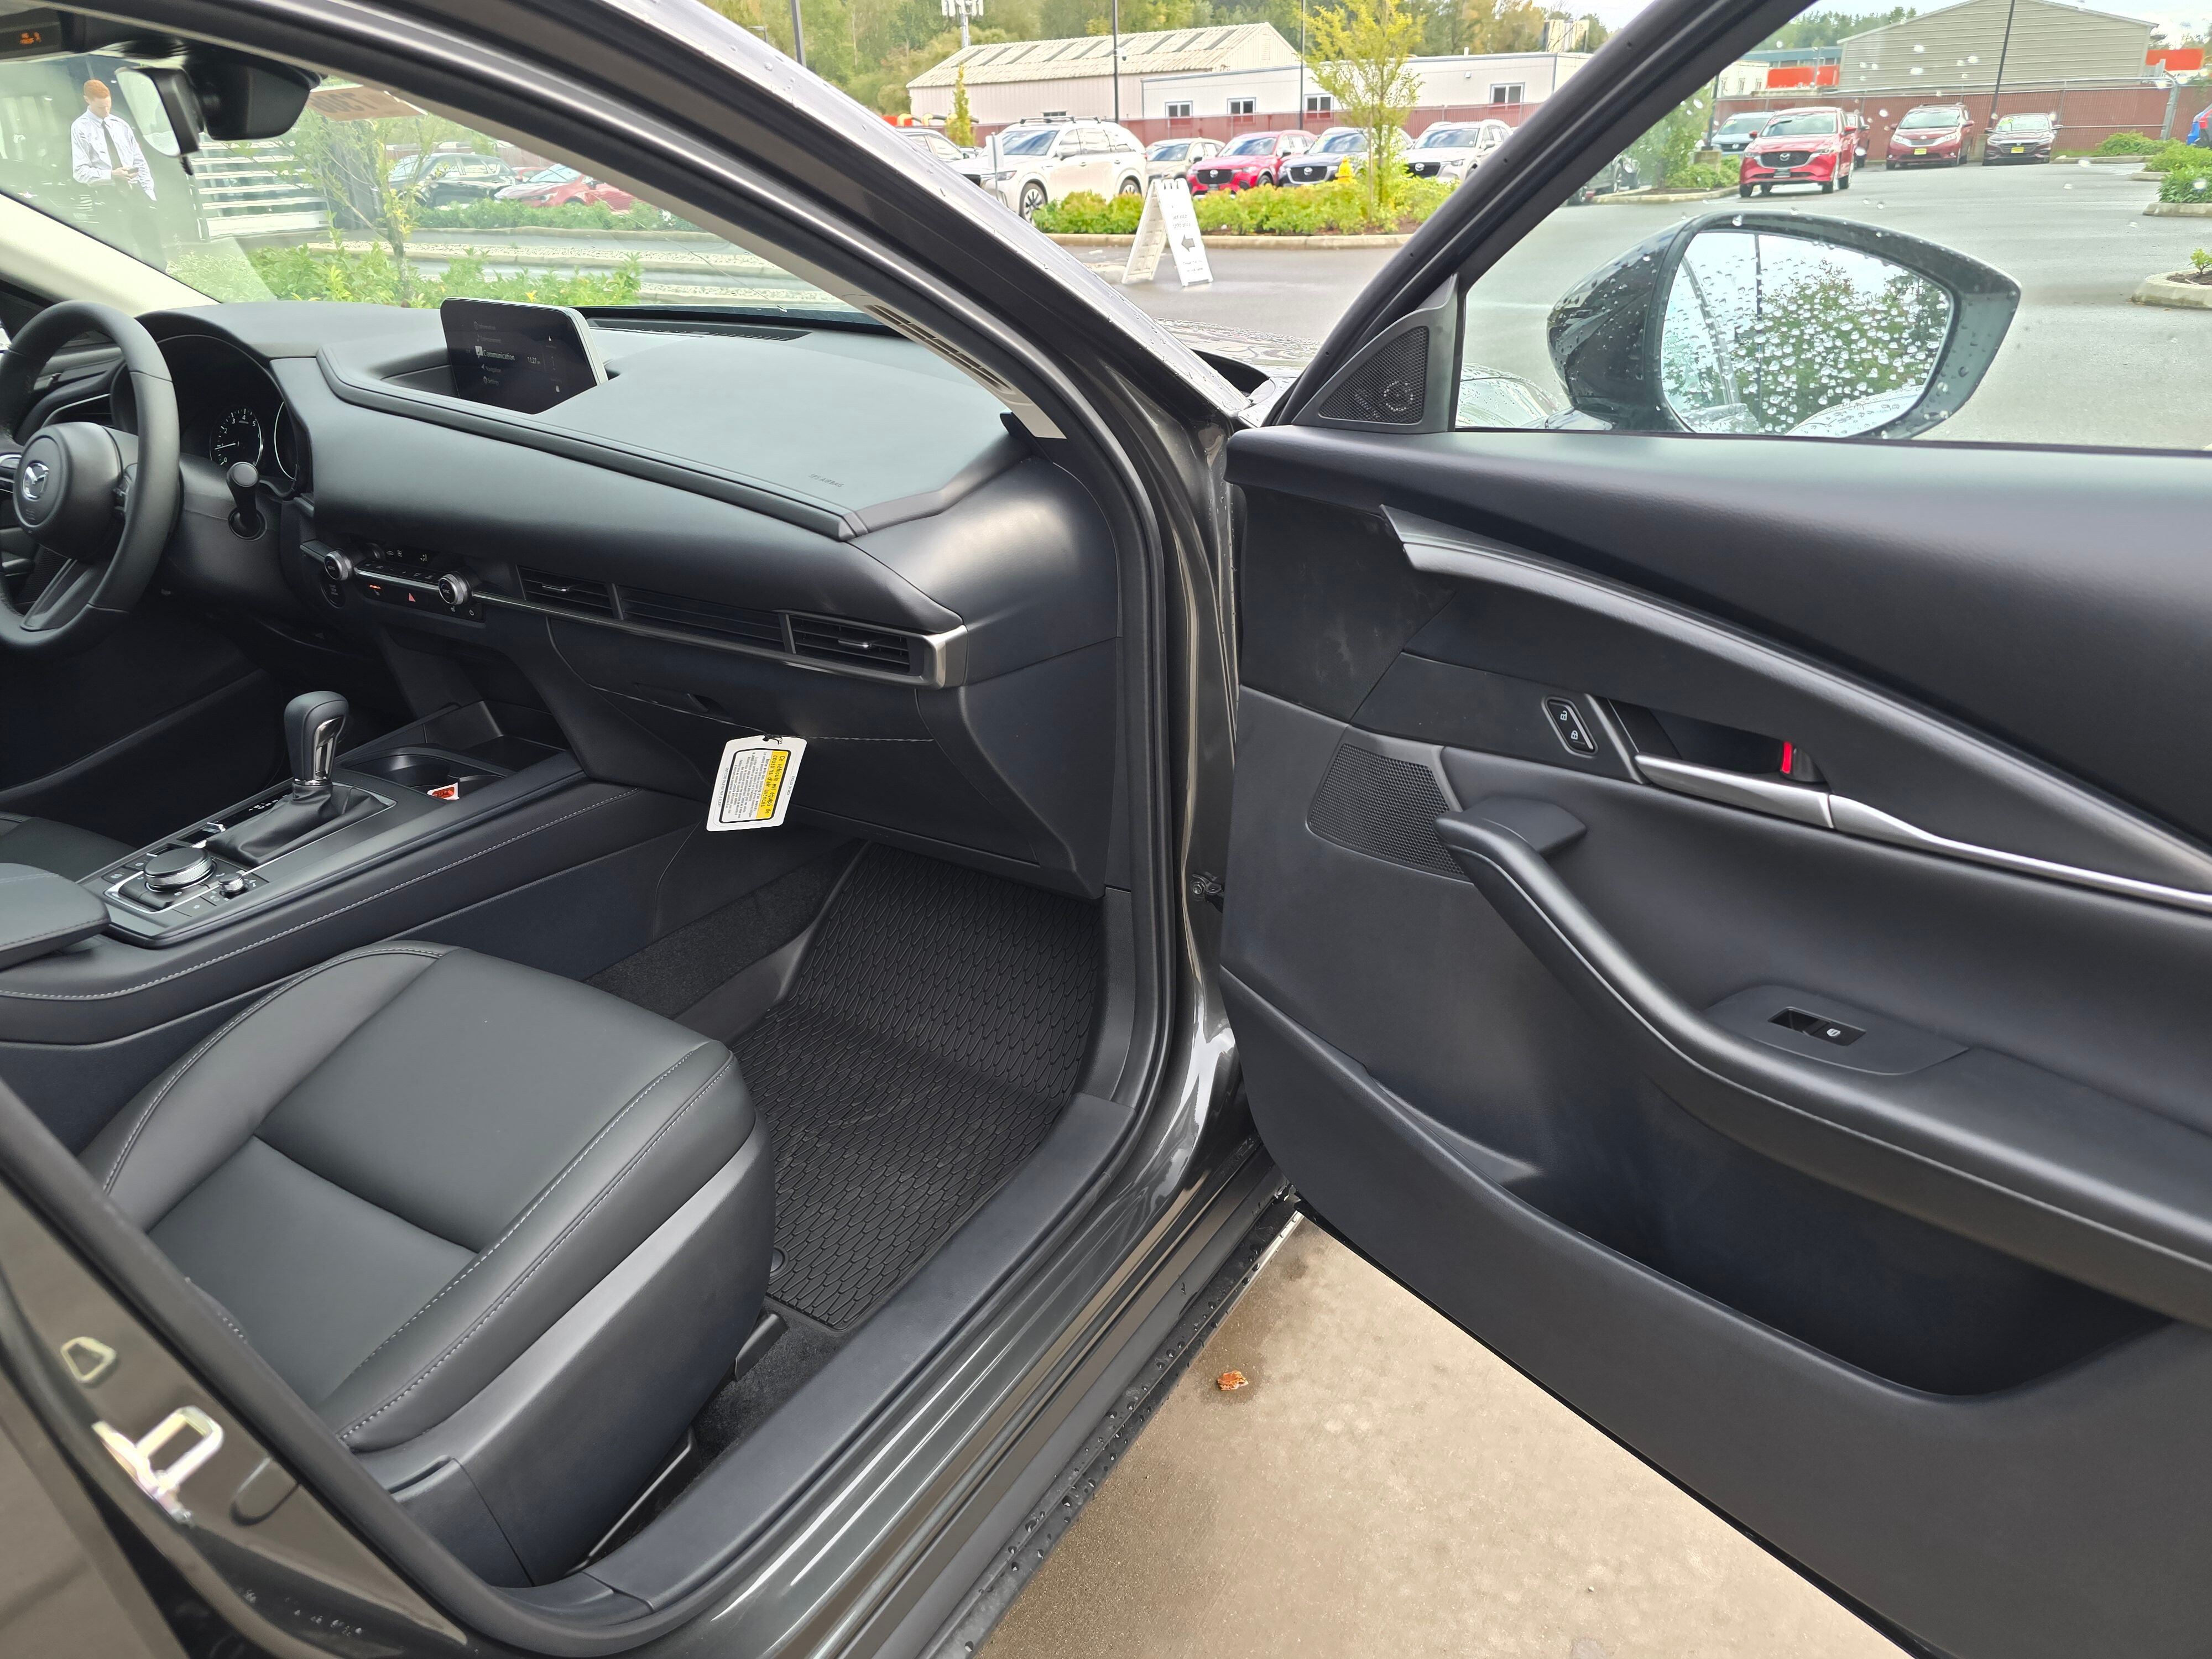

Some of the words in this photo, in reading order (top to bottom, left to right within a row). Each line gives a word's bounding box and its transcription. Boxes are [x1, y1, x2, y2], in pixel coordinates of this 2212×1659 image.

[483, 349, 515, 361] Communication
[818, 478, 844, 487] AIRBAG
[774, 764, 782, 781] véhicule
